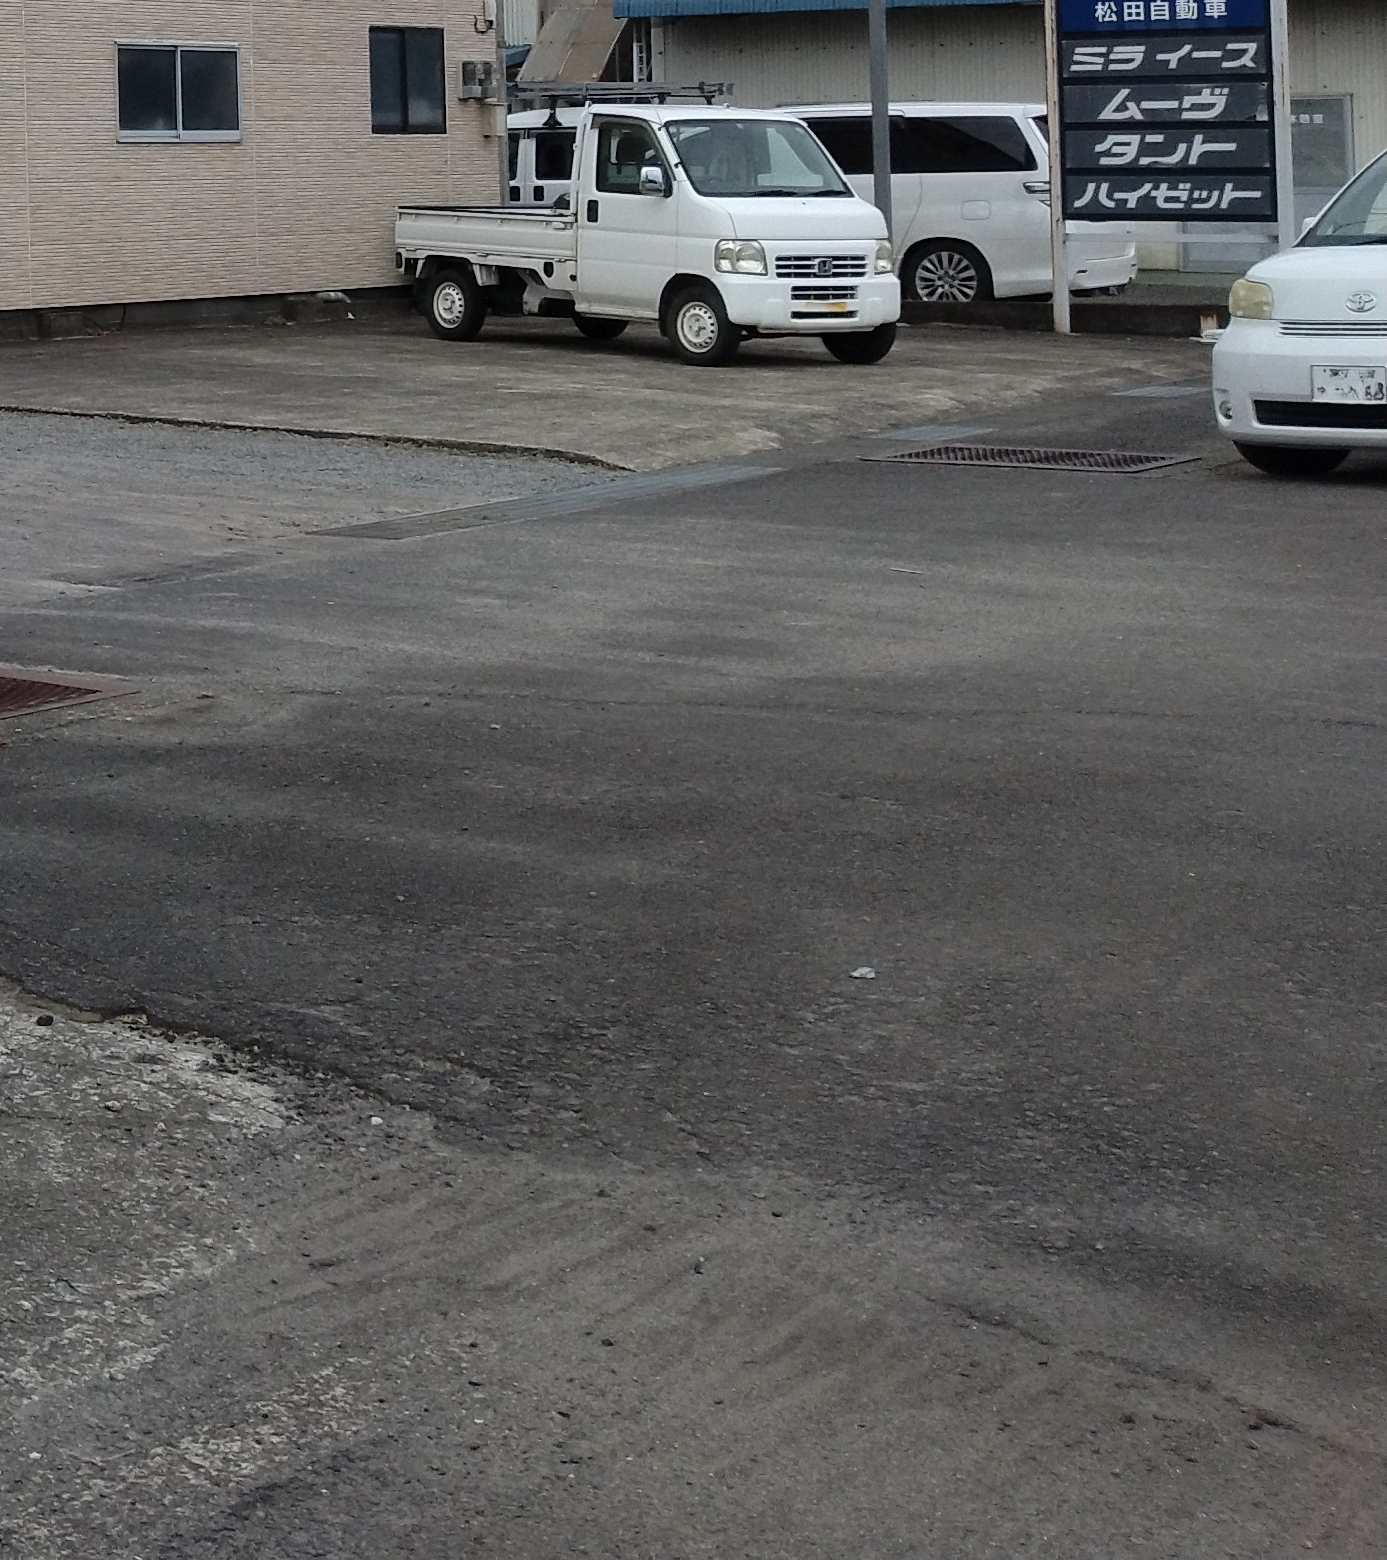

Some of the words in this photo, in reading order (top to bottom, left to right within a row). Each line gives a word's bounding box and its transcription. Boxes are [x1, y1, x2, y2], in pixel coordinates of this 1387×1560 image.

[1097, 87, 1230, 121] ムーヴ
[1094, 133, 1237, 166] タント
[1073, 181, 1263, 210] ハイゼット
